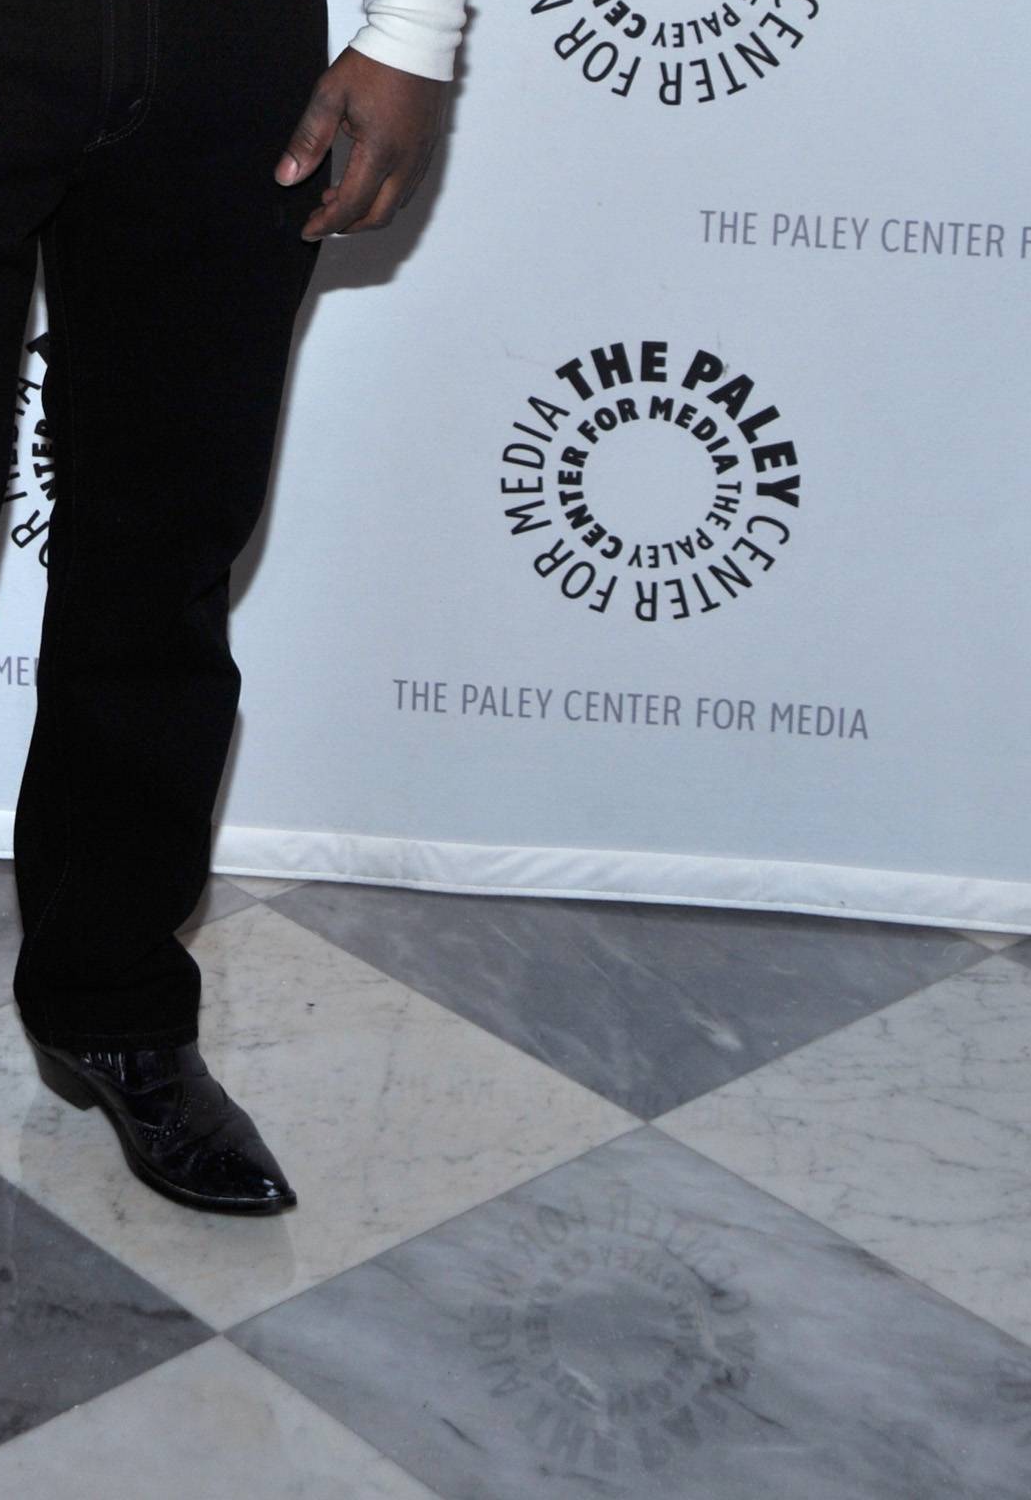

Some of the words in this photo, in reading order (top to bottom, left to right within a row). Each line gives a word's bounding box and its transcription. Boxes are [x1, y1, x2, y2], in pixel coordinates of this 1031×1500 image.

[554, 17, 641, 97] FOR
[651, 3, 741, 48] PALEY
[700, 210, 758, 245] THE
[773, 213, 869, 250] PALEY
[881, 219, 1005, 258] CENTER
[555, 341, 668, 401] THE
[577, 398, 640, 444] FOR
[649, 396, 739, 475] MEDIA
[681, 350, 800, 508] PALEY
[501, 396, 570, 535] MEDIA
[558, 446, 623, 559] CENTER
[705, 481, 741, 531] THE
[533, 538, 618, 613] FOR
[628, 527, 714, 568] PALEY
[635, 516, 790, 622] CENTER
[392, 679, 447, 713] THE
[462, 684, 553, 719] PALEY
[564, 690, 681, 726] CENTER
[696, 697, 755, 731] FOR
[770, 702, 868, 740] MEDIA
